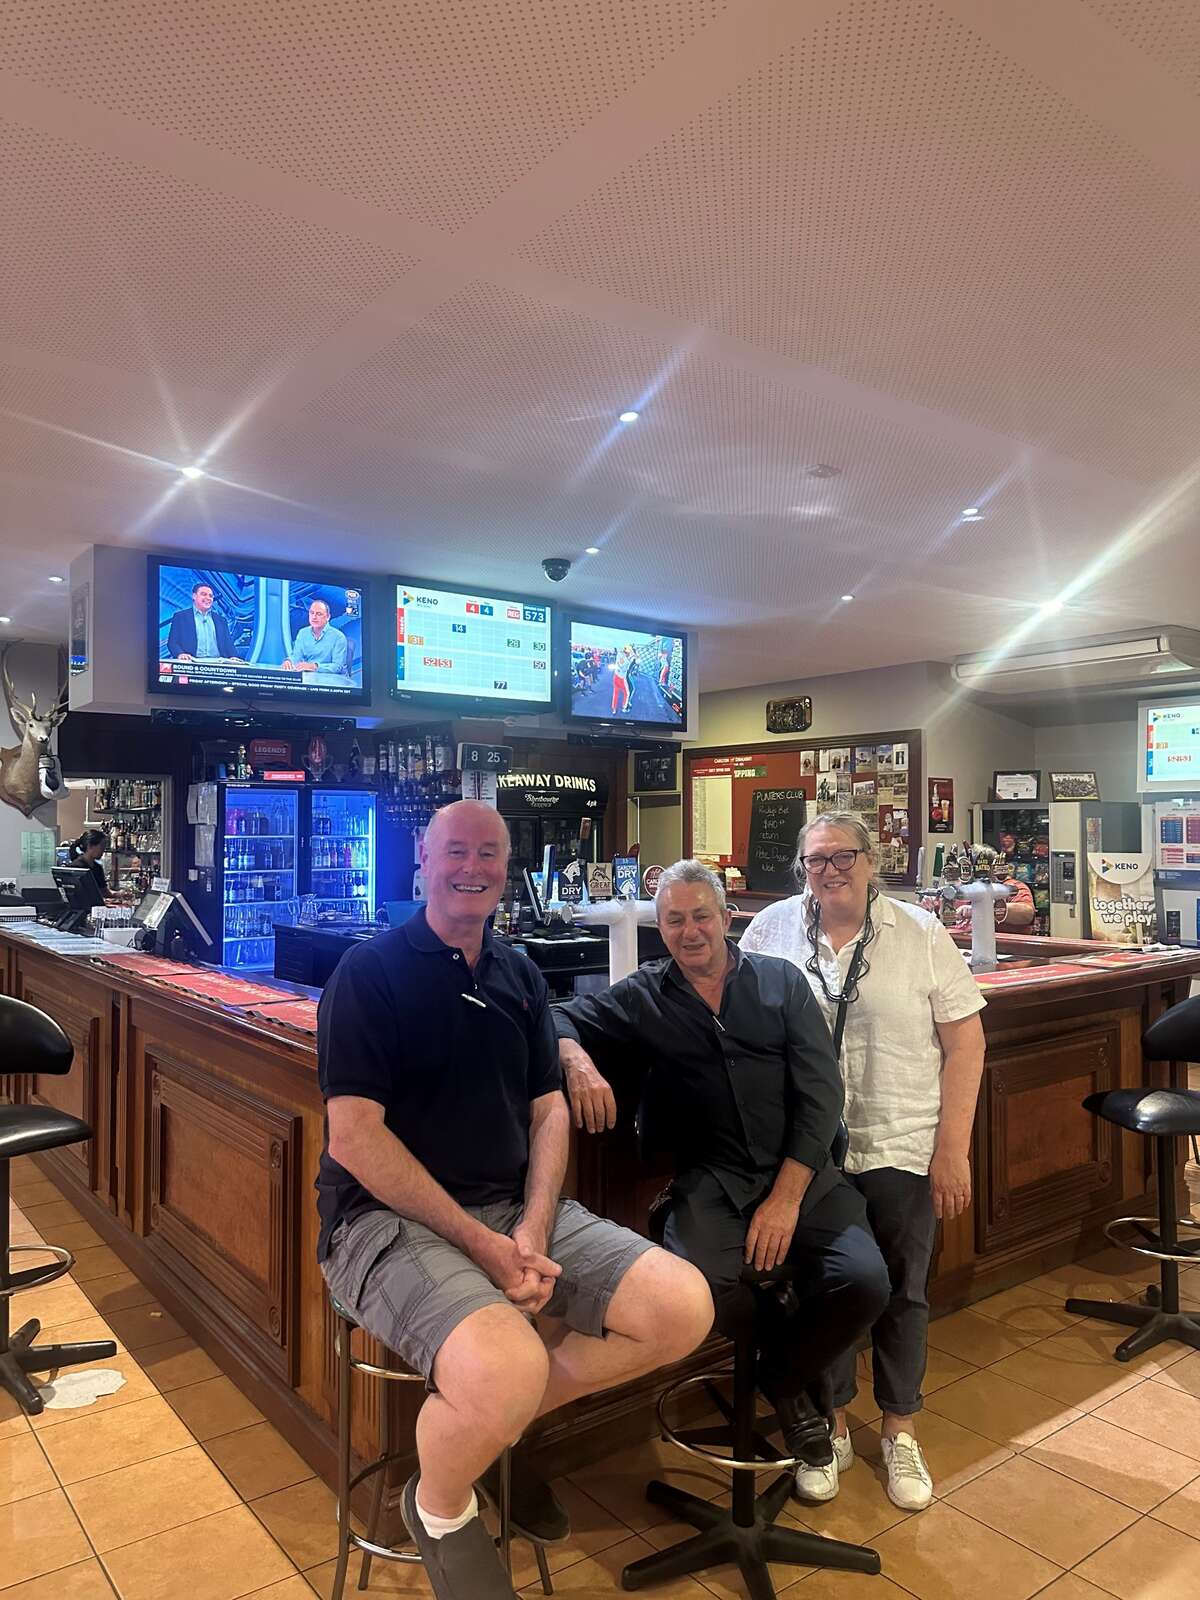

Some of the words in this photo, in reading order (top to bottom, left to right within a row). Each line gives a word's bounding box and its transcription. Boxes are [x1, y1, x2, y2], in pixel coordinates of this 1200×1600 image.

[416, 596, 438, 606] KENO
[525, 611, 544, 622] 573
[425, 658, 435, 667] 52
[439, 659, 450, 668] 53
[200, 666, 237, 674] COUNTDOWN
[254, 746, 287, 754] LEGENDS
[471, 750, 479, 762] 8
[487, 752, 501, 763] 25
[554, 775, 597, 792] DRINKS
[756, 791, 785, 801] PUNTERS
[786, 790, 804, 799] CLUB
[1114, 862, 1139, 870] KENO
[617, 870, 637, 879] DRY
[561, 887, 581, 895] DRY
[1093, 897, 1150, 914] together
[1102, 913, 1122, 923] we
